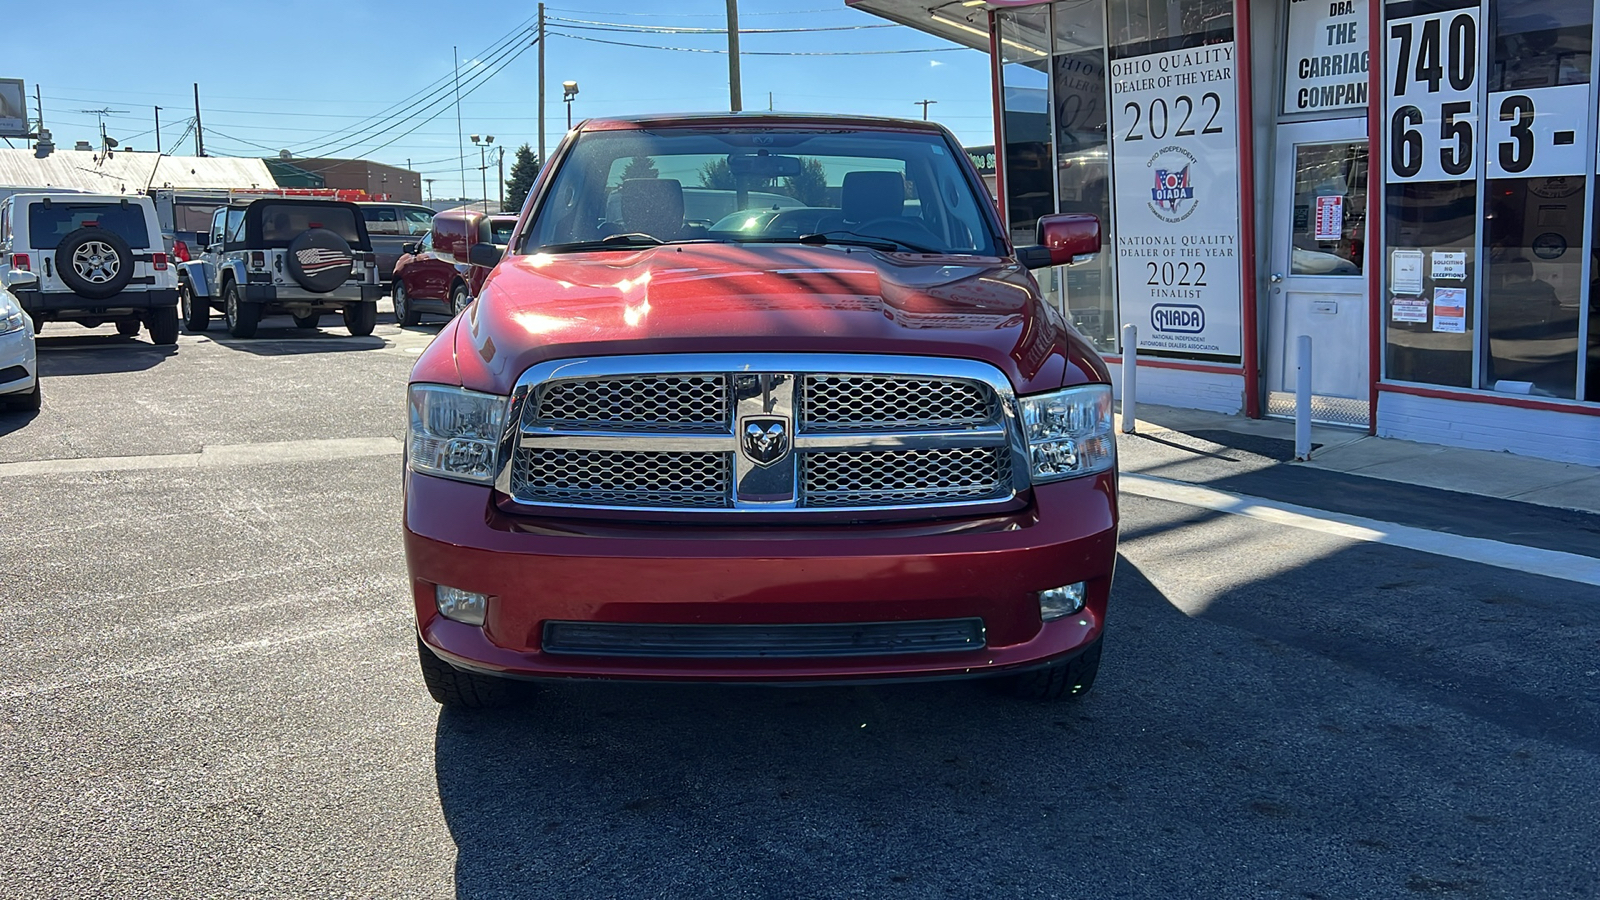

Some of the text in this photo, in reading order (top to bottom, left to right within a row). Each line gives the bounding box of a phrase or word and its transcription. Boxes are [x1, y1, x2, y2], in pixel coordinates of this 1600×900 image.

[1329, 1, 1355, 17] DBA.
[1326, 21, 1357, 46] THE
[1112, 59, 1152, 77] OHIO
[1159, 46, 1233, 73] QUALITY
[1298, 50, 1370, 79] CARRIAG
[1390, 13, 1476, 97] 740
[1114, 77, 1155, 94] DEALER
[1157, 75, 1172, 88] OF
[1174, 71, 1198, 86] THE
[1199, 67, 1231, 83] YEAR
[1297, 82, 1369, 109] COMPAN
[1124, 92, 1223, 142] 2022
[1147, 145, 1198, 168] OHIO INDEPENDENT
[1156, 189, 1187, 200] OIADA
[1119, 235, 1235, 246] NATIONAL QUALITY
[1120, 248, 1234, 257] DEALER OF THE YEAR
[1146, 261, 1207, 287] 2022
[1151, 288, 1202, 299] FINALIST
[1140, 340, 1167, 348] AUTOMOBILE
[1188, 343, 1220, 351] ASSOCIATION
